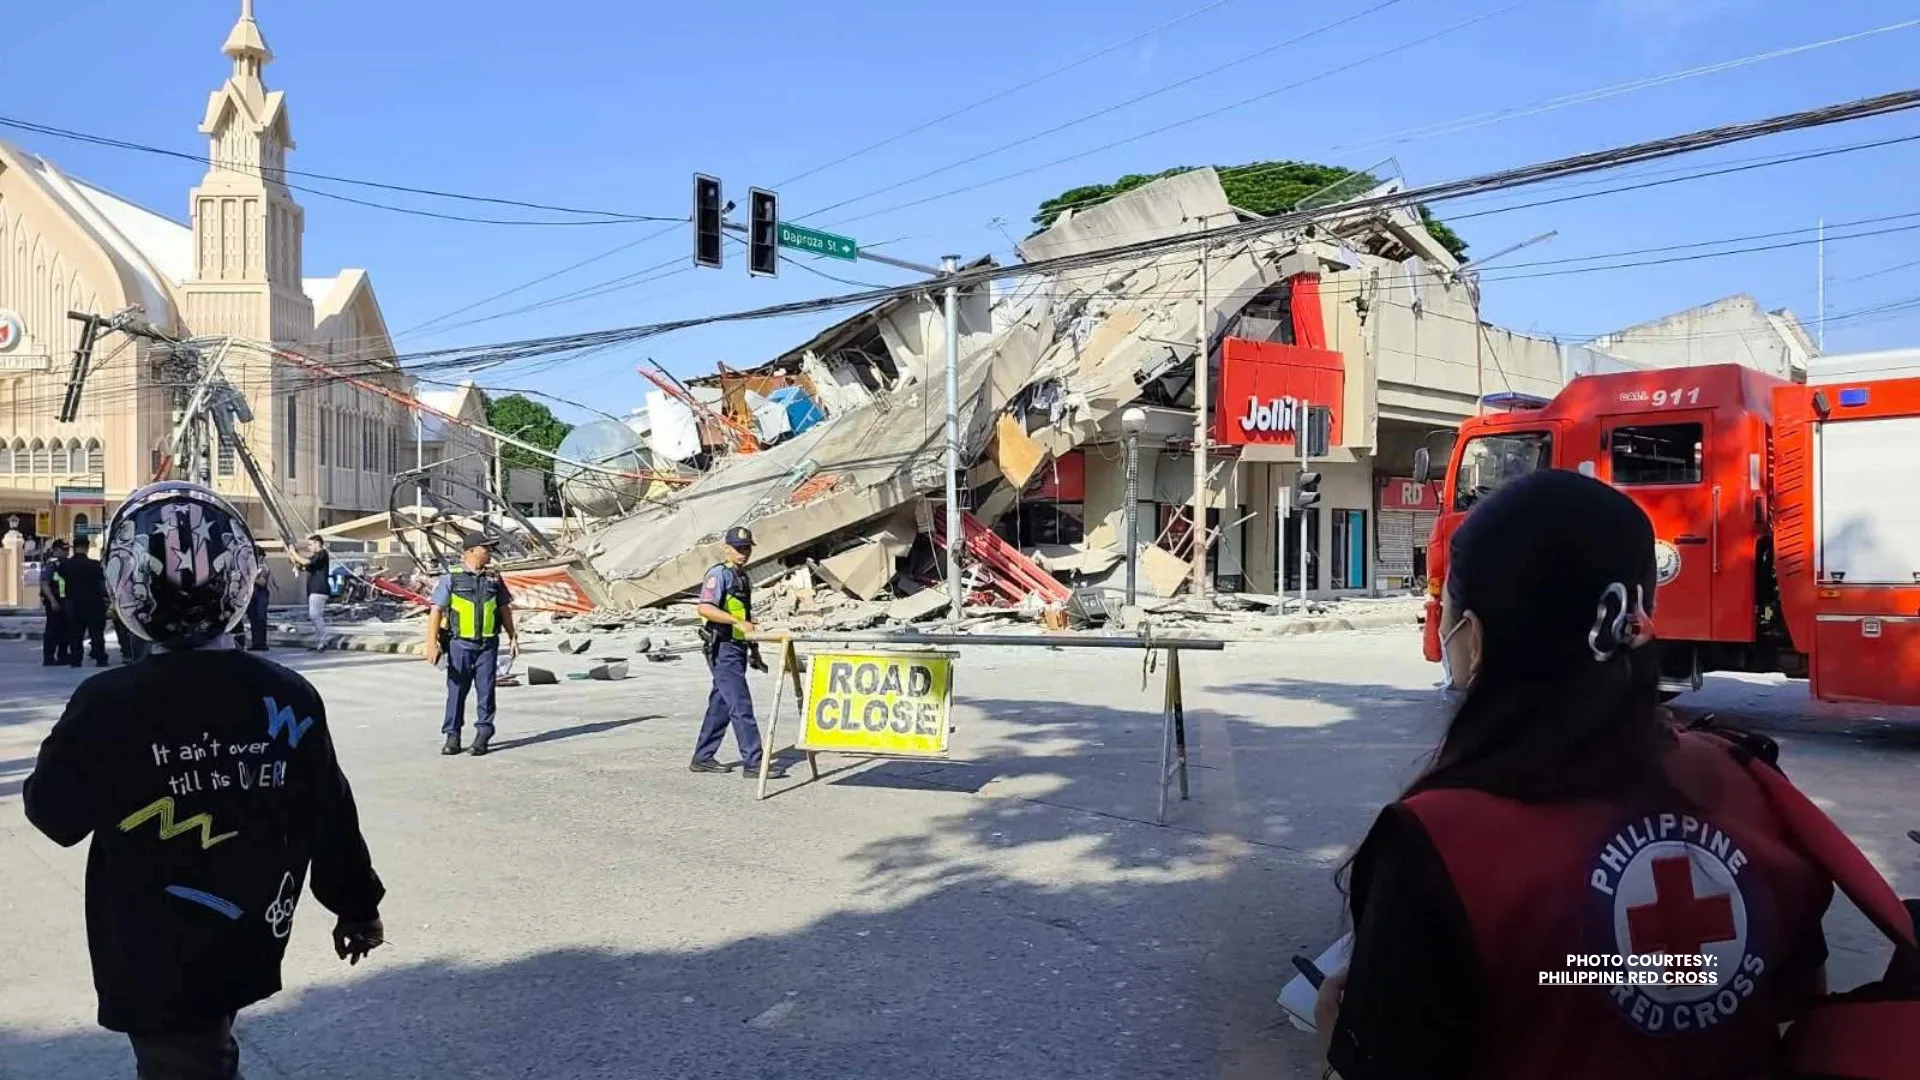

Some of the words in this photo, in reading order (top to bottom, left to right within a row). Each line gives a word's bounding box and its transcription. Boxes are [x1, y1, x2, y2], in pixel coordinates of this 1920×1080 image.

[783, 229, 823, 248] Daproza
[1651, 387, 1700, 406] 911
[1402, 482, 1423, 505] RD
[829, 662, 932, 697] ROAD
[815, 698, 939, 735] CLOSE
[152, 743, 170, 766] It
[180, 732, 221, 761] ain't
[229, 742, 269, 755] over
[168, 770, 202, 796] till
[1591, 813, 1748, 895] PHILIPPINE
[1610, 984, 1664, 1031] RED
[1673, 953, 1765, 1030] CROSS
